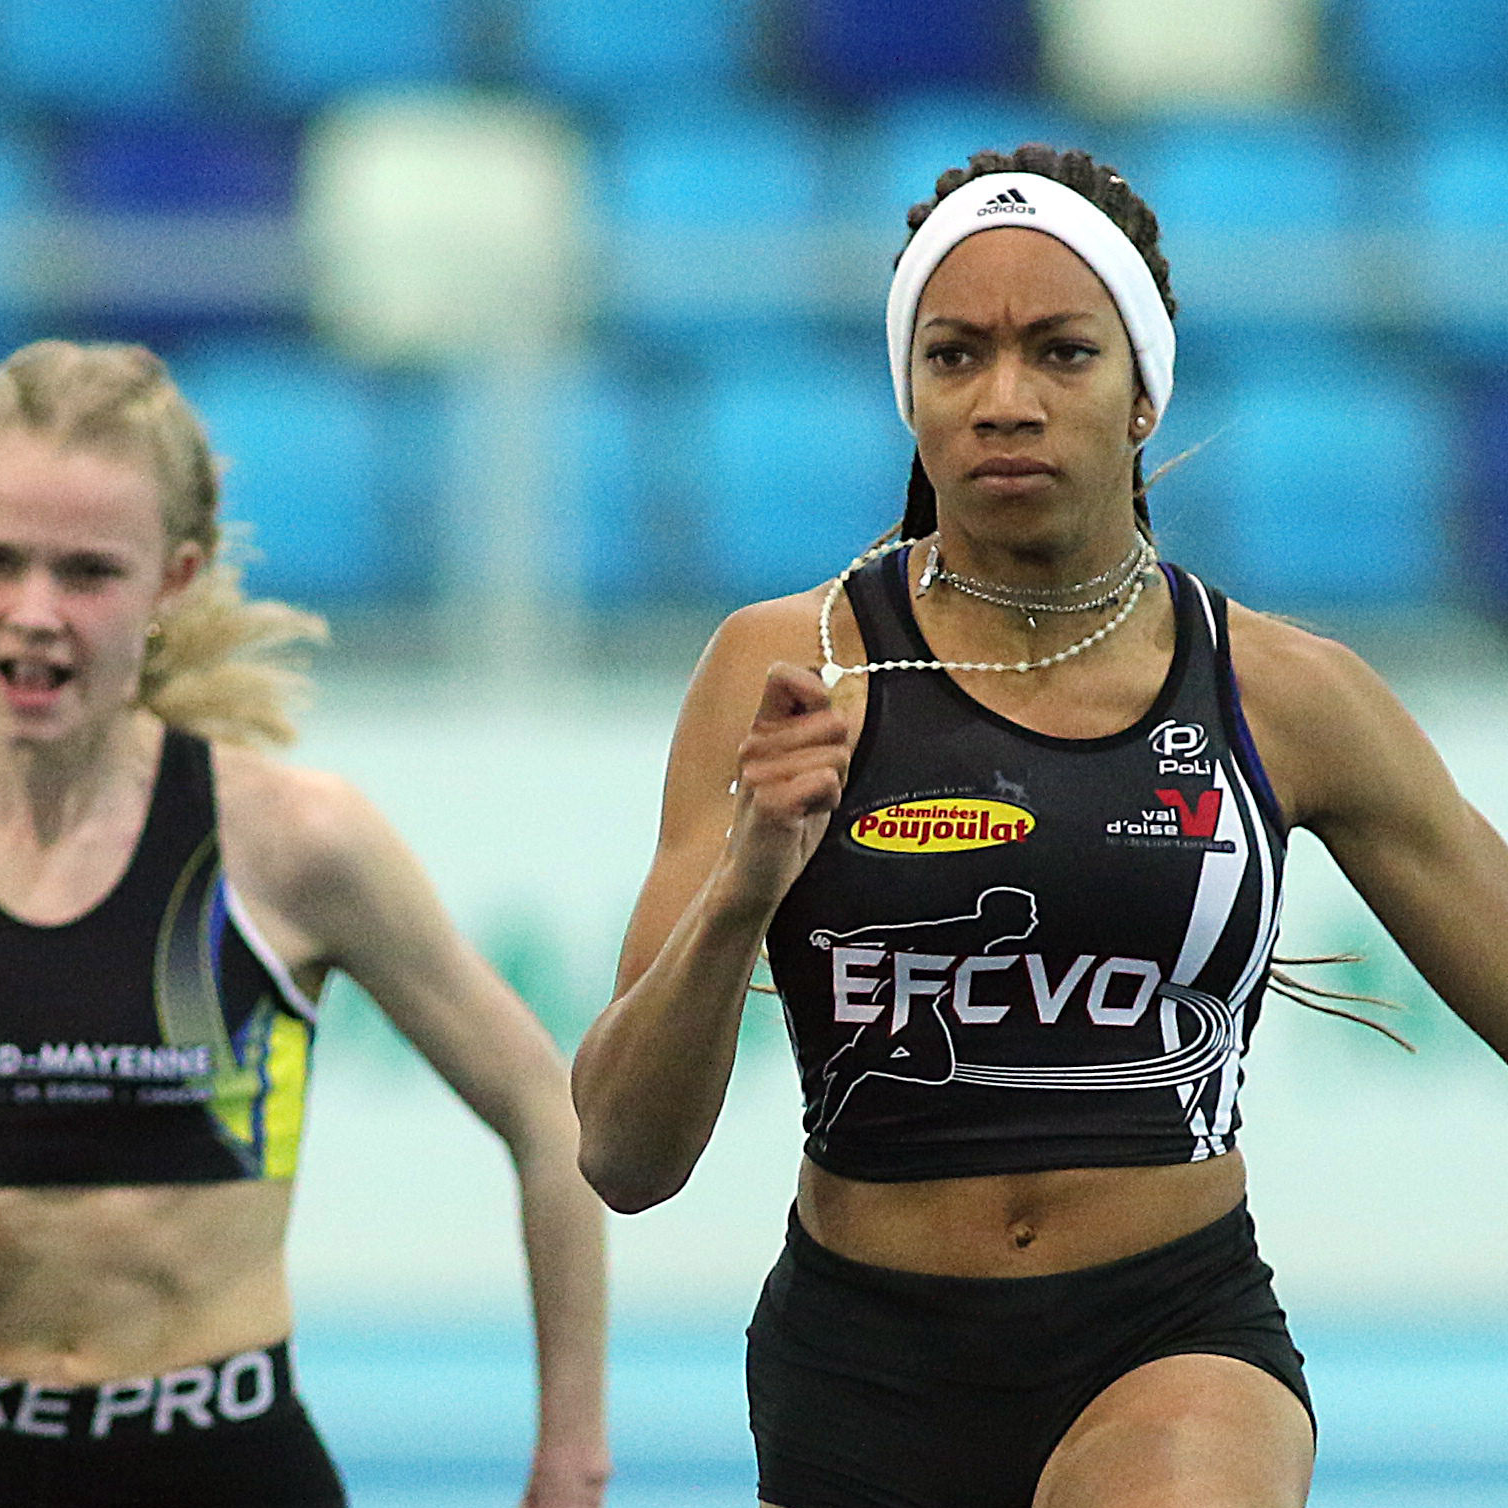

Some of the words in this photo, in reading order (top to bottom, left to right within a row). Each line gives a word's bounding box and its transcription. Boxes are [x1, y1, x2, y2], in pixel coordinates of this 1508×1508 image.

[976, 203, 1037, 217] adidas
[886, 804, 979, 820] cheminées
[1141, 808, 1177, 822] val
[857, 811, 1029, 846] Poujoulat
[831, 945, 1162, 1037] EFCVO
[88, 1350, 275, 1439] PRO
